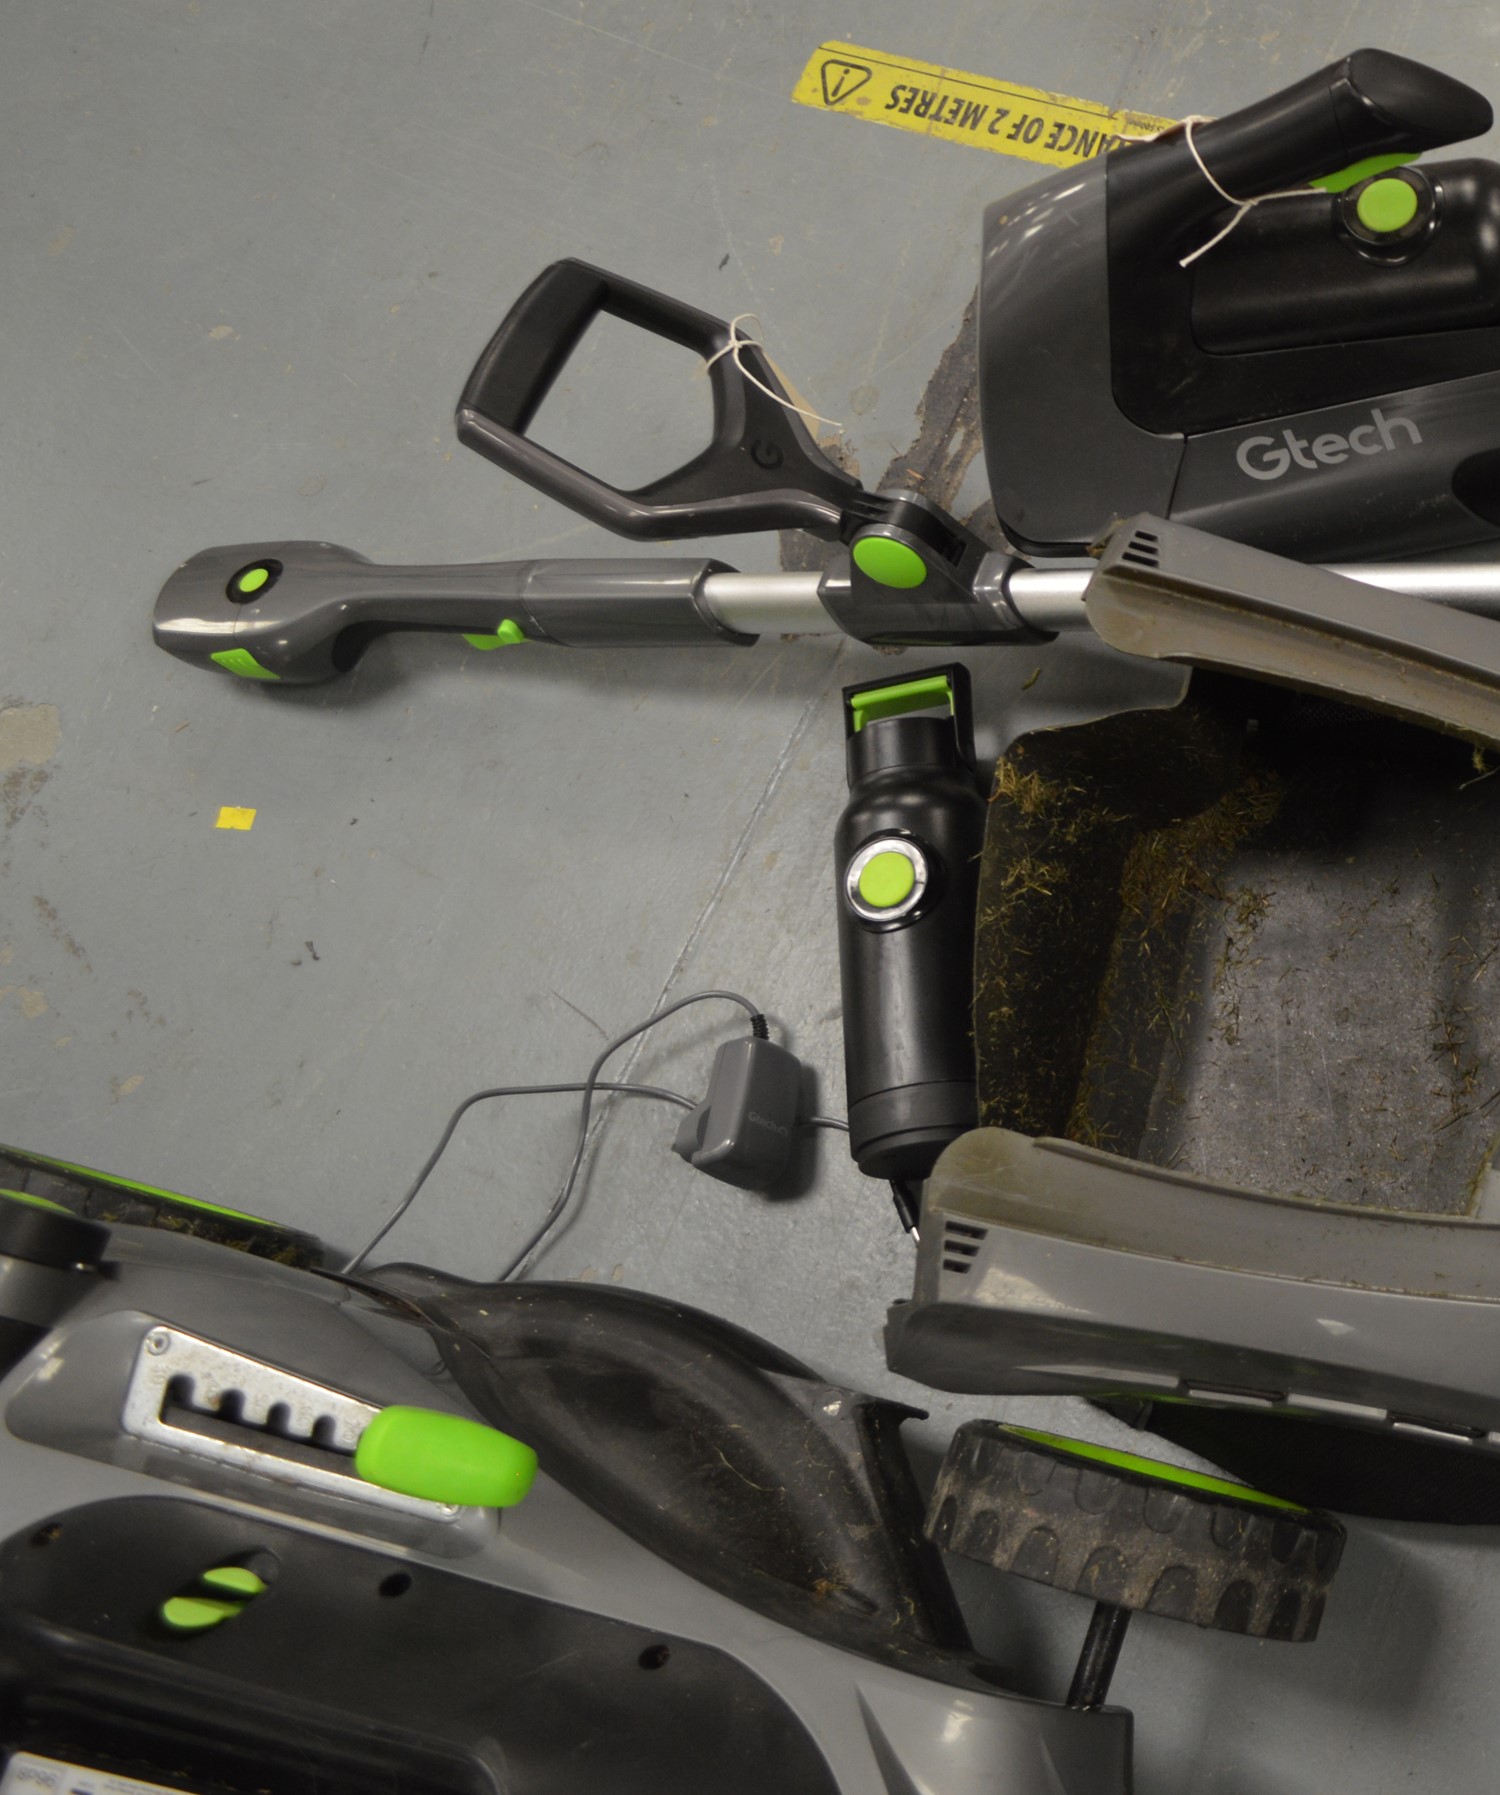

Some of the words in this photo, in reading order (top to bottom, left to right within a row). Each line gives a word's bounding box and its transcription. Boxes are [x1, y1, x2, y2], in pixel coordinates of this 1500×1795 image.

[884, 84, 989, 131] METRES
[987, 107, 1010, 135] 2
[1006, 113, 1045, 145] OF
[1043, 121, 1127, 158] ANCE
[1236, 408, 1423, 481] Gtech
